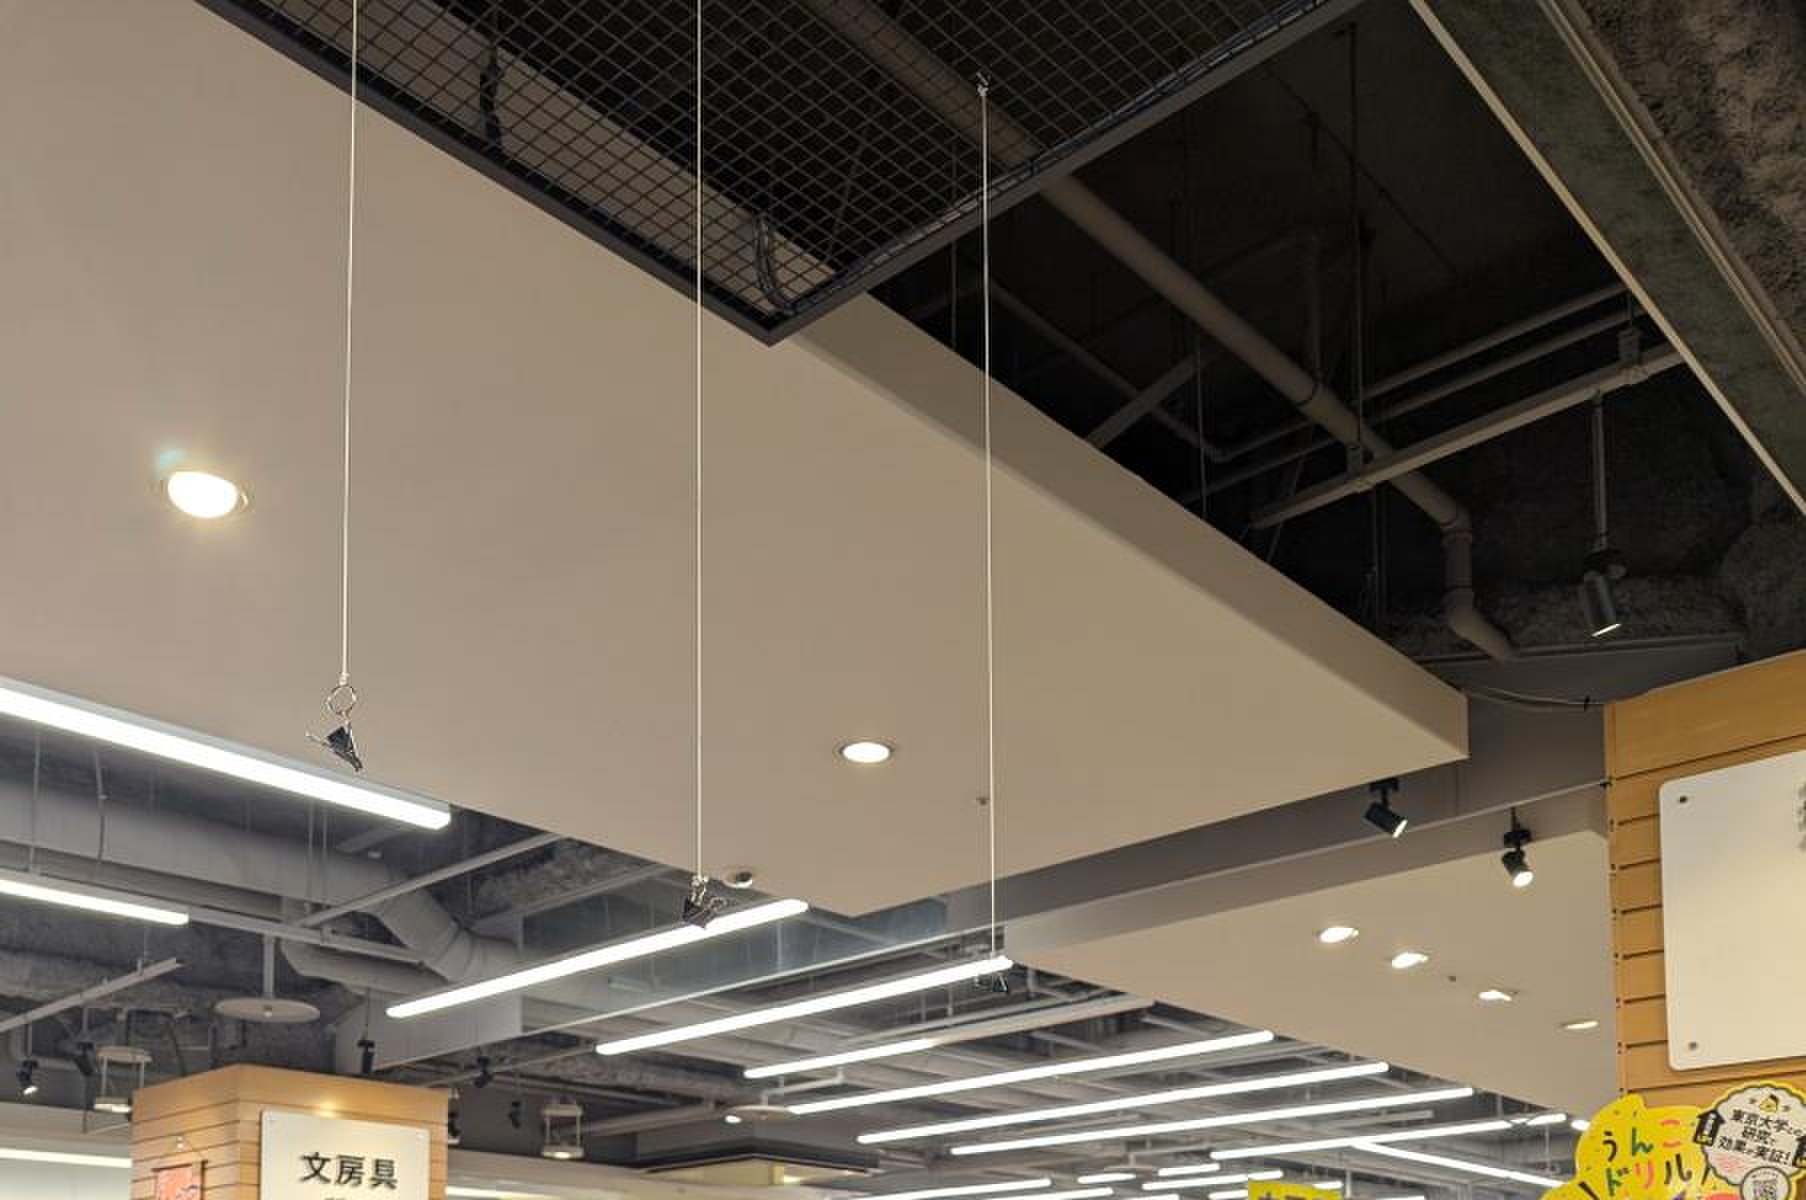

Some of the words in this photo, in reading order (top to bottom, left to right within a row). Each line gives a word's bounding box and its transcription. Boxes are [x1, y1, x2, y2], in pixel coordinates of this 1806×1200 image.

[1602, 1118, 1682, 1162] うんこ
[300, 1151, 399, 1191] 文房具
[1606, 1154, 1692, 1197] ドリル
